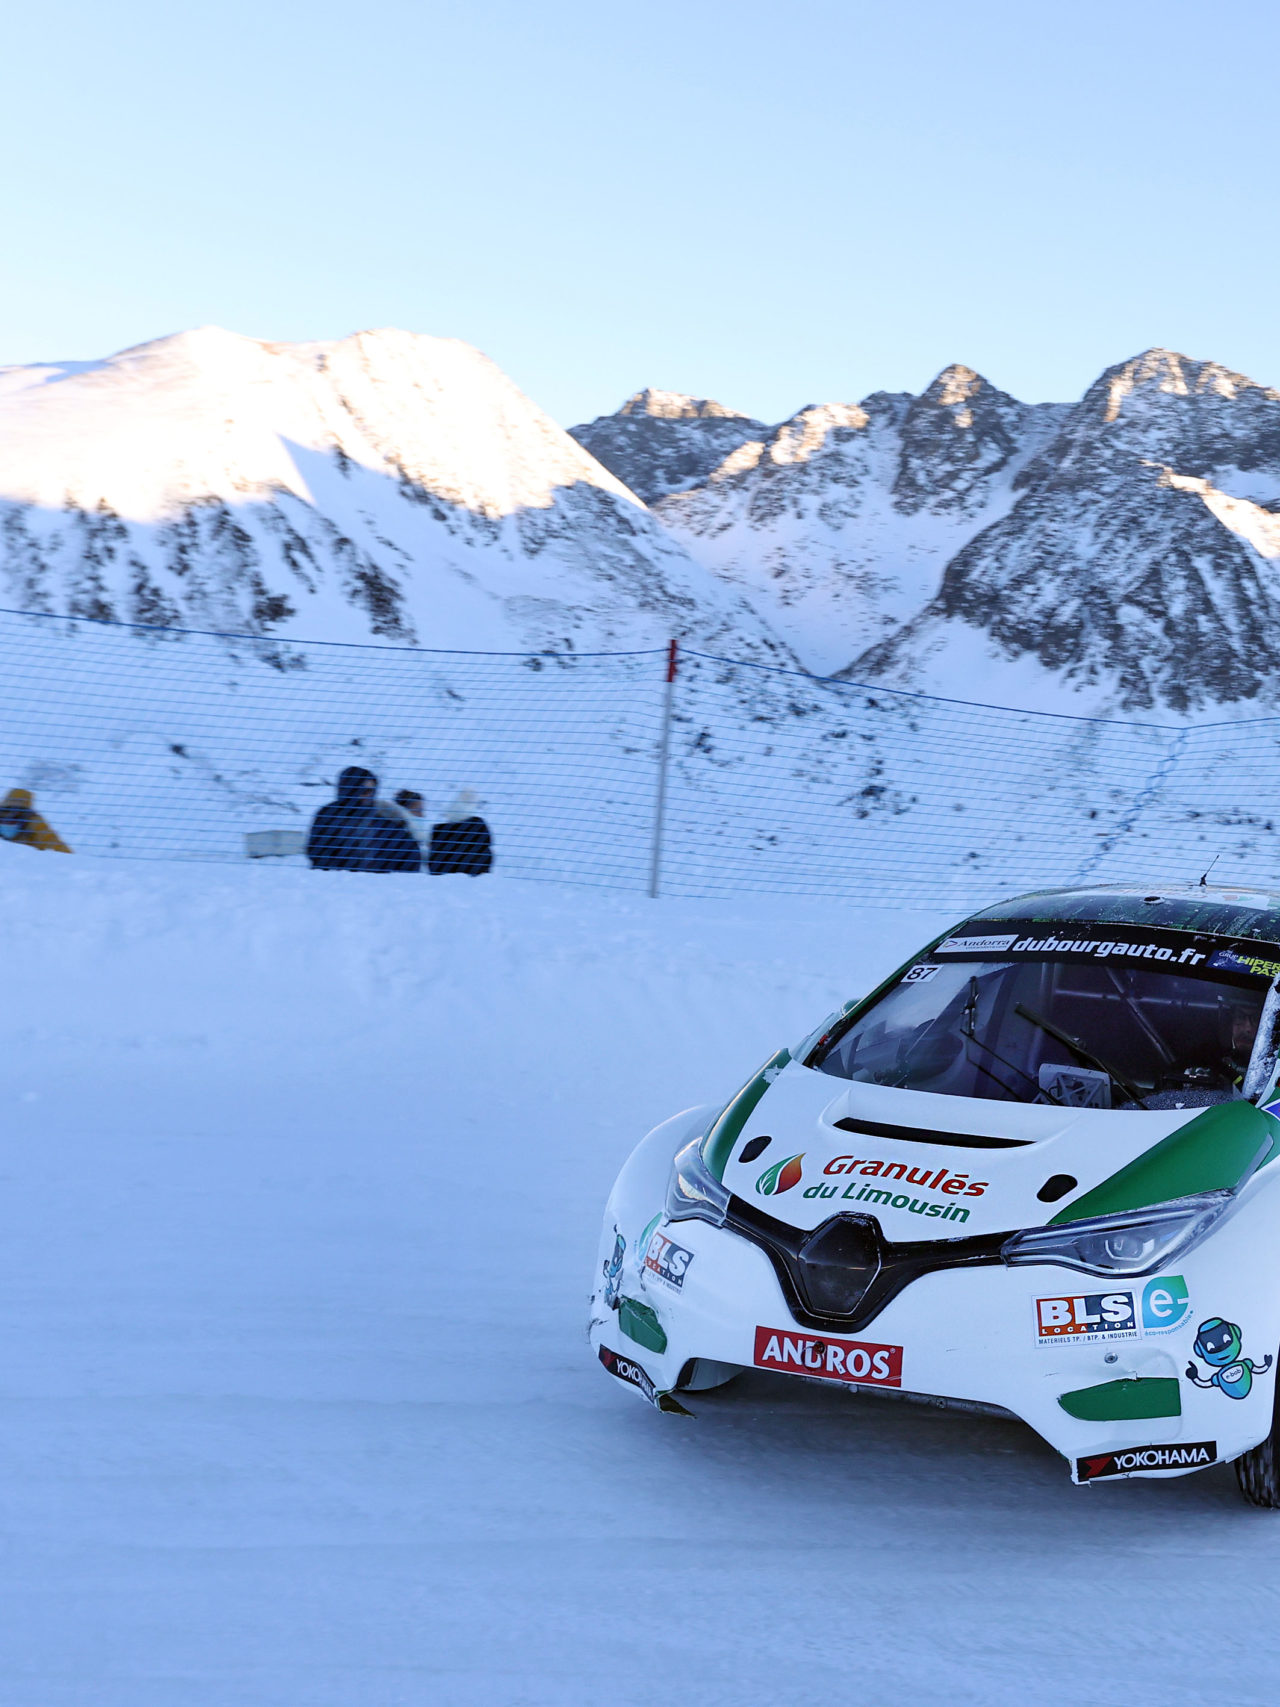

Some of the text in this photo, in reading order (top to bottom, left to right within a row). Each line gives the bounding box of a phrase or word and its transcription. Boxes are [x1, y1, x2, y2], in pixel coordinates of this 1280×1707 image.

[958, 939, 1010, 948] Andorra
[1012, 936, 1206, 965] dubourgauto.fr
[906, 967, 938, 980] 87
[1250, 966, 1280, 978] PAS
[822, 1155, 989, 1197] Granulés
[803, 1182, 971, 1224] du Limousin
[646, 1235, 690, 1277] BLS
[1039, 1295, 1133, 1327] BLS
[1039, 1336, 1071, 1345] MATERIELS
[1107, 1331, 1138, 1339] INDUSTRIE
[1041, 1321, 1134, 1335] LOCATION
[762, 1335, 890, 1380] ANDROS
[1113, 1448, 1210, 1470] YOKOHAMA
